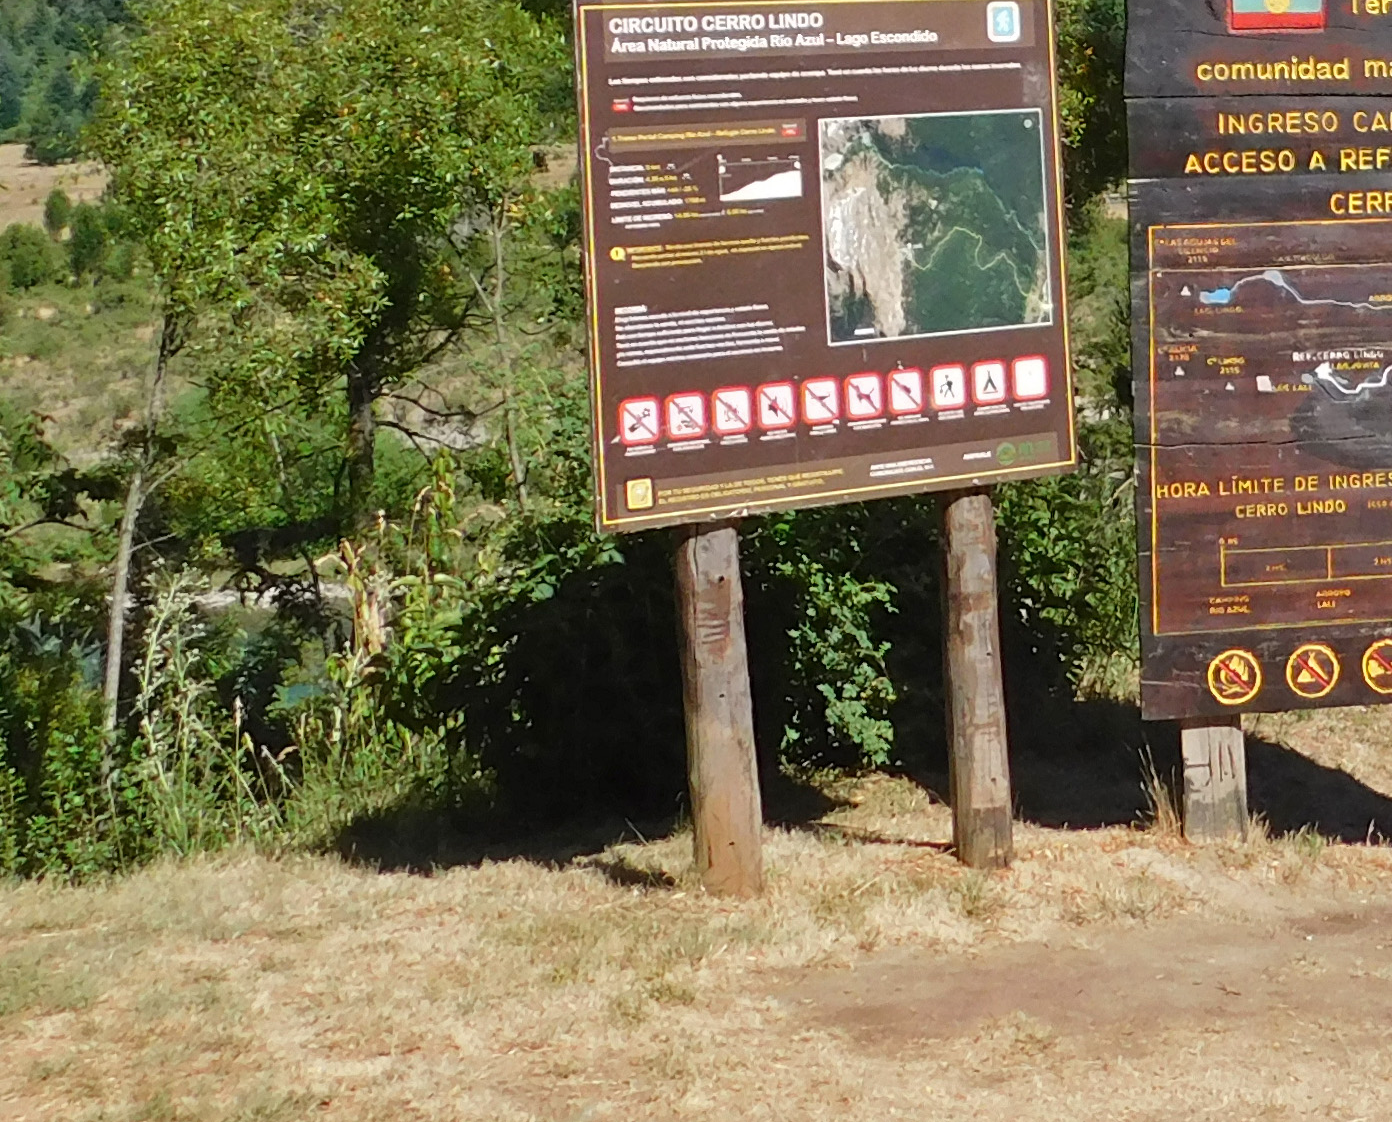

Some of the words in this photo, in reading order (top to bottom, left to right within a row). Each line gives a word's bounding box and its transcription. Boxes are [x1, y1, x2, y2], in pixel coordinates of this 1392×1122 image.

[609, 16, 698, 34] CIRCUITO
[701, 14, 765, 31] CERRO
[768, 13, 823, 28] LINDO
[611, 38, 646, 53] Área
[648, 38, 699, 52] Natural
[702, 35, 768, 51] Protegida
[770, 35, 793, 48] Río
[795, 33, 824, 46] Azul
[836, 33, 868, 47] Lago
[871, 30, 938, 44] Escondido
[1197, 56, 1350, 80] comunidad
[1219, 111, 1339, 134] INGRESO
[1184, 149, 1296, 174] ACCESO
[1308, 150, 1327, 171] A
[1156, 482, 1210, 499] HORA
[1219, 476, 1285, 496] LÍMITE
[1295, 476, 1319, 491] DE
[1235, 503, 1288, 518] CERRO
[1297, 499, 1347, 515] LINDO
